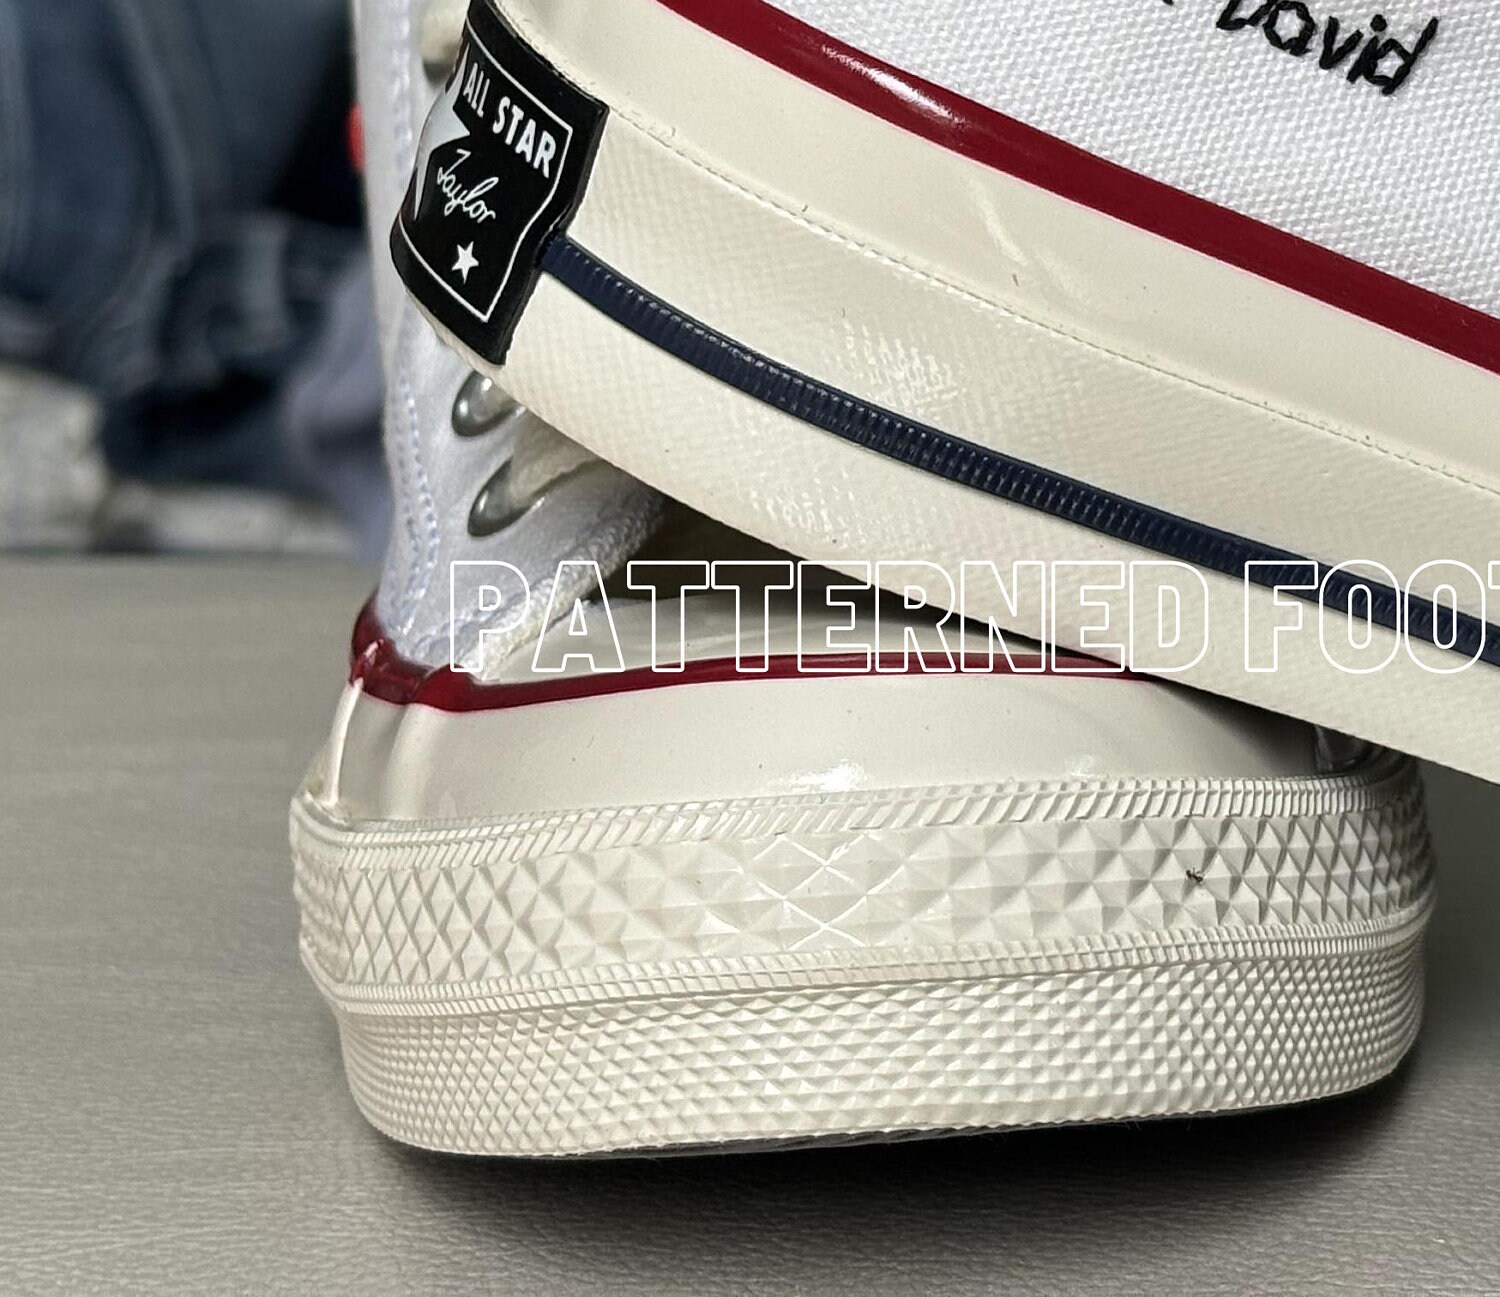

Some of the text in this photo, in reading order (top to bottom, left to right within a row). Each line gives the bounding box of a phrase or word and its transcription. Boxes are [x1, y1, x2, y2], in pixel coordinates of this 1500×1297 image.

[462, 61, 557, 179] ALL STAR
[436, 148, 499, 224] Taylor
